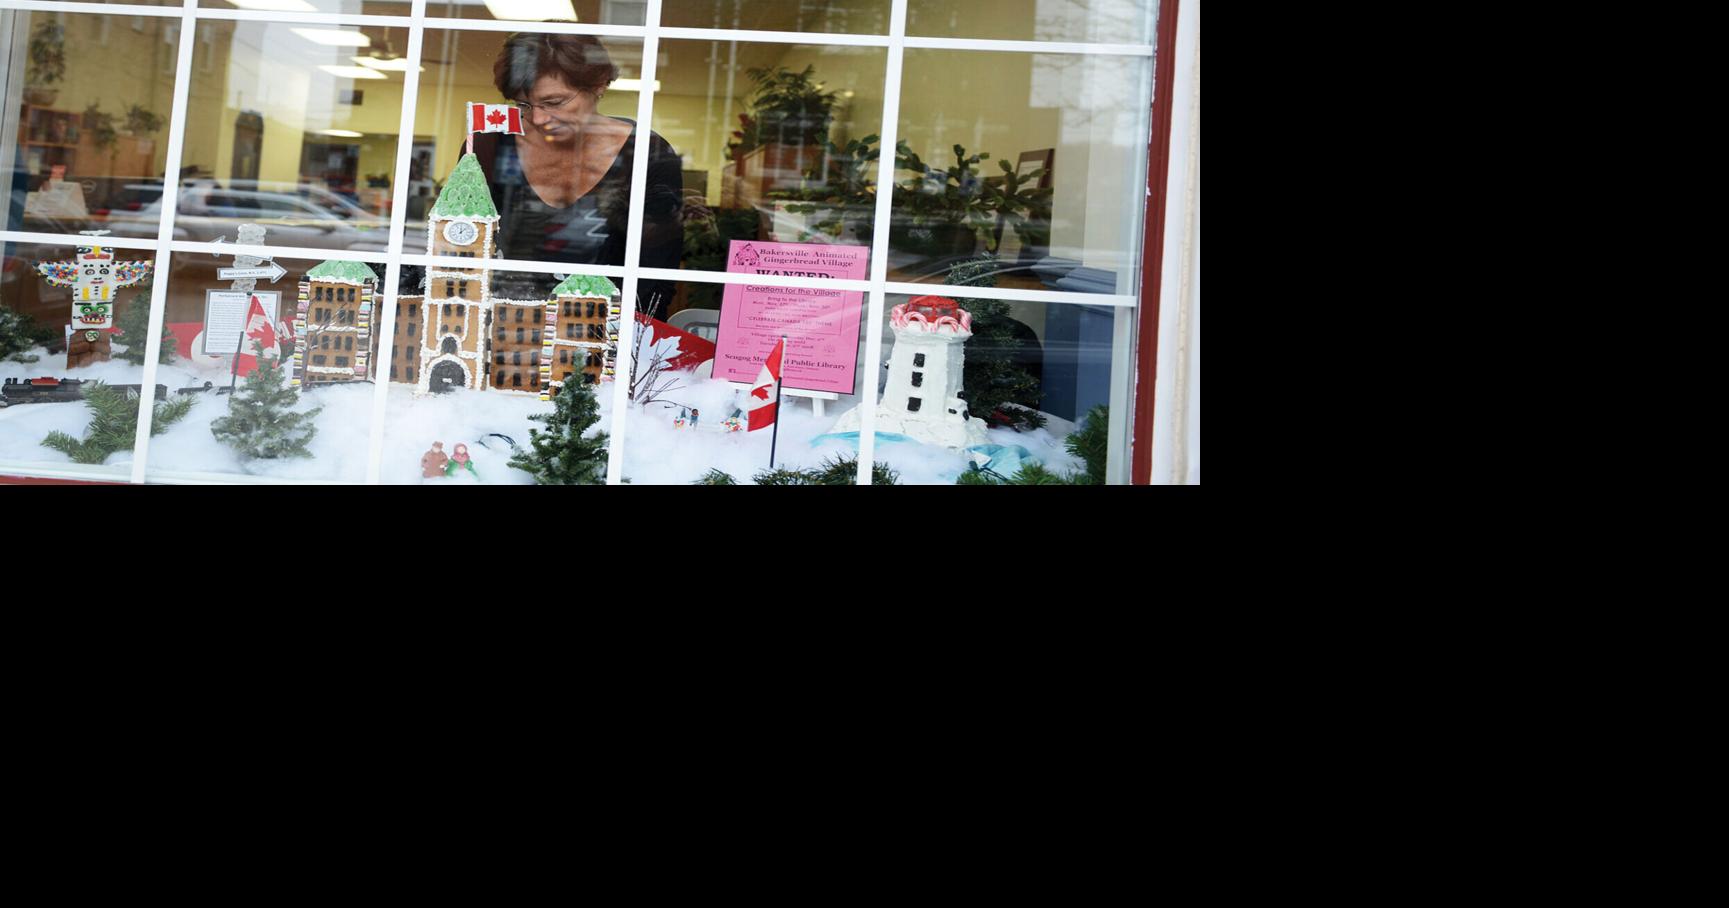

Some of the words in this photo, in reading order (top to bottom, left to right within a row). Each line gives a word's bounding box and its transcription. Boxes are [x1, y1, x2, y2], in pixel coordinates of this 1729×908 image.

[763, 256, 820, 266] Gingerbread
[822, 259, 854, 268] Village
[745, 285, 784, 294] Creations
[785, 287, 797, 295] for
[798, 288, 811, 296] the
[813, 289, 841, 297] Village
[790, 359, 816, 368] Public
[817, 361, 846, 371] Library
